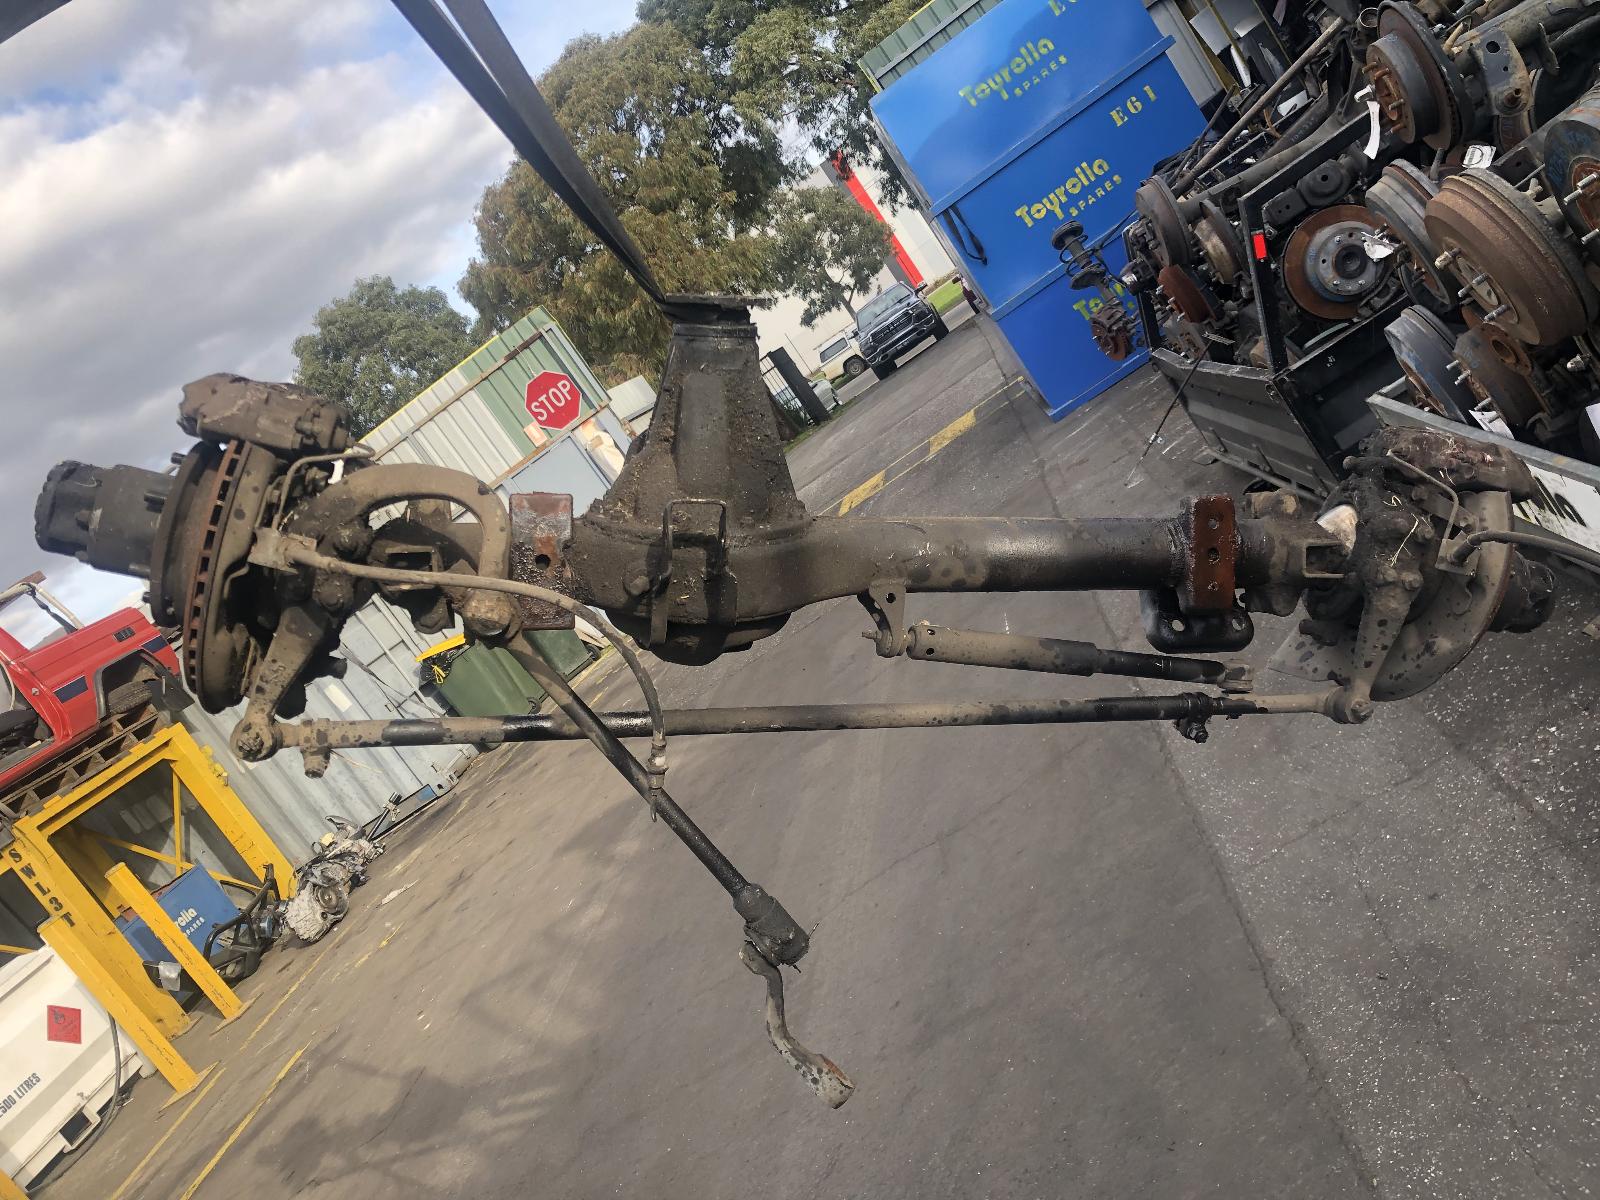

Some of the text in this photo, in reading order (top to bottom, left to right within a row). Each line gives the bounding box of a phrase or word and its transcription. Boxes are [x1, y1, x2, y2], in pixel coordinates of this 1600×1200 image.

[959, 38, 1055, 107] Toyrolla
[1014, 54, 1067, 97] SPARES
[1015, 158, 1110, 228] Toyrolla
[1069, 174, 1122, 217] SPARES
[531, 380, 572, 421] STOP
[174, 908, 198, 928] rolla
[13, 1072, 41, 1100] LITRES
